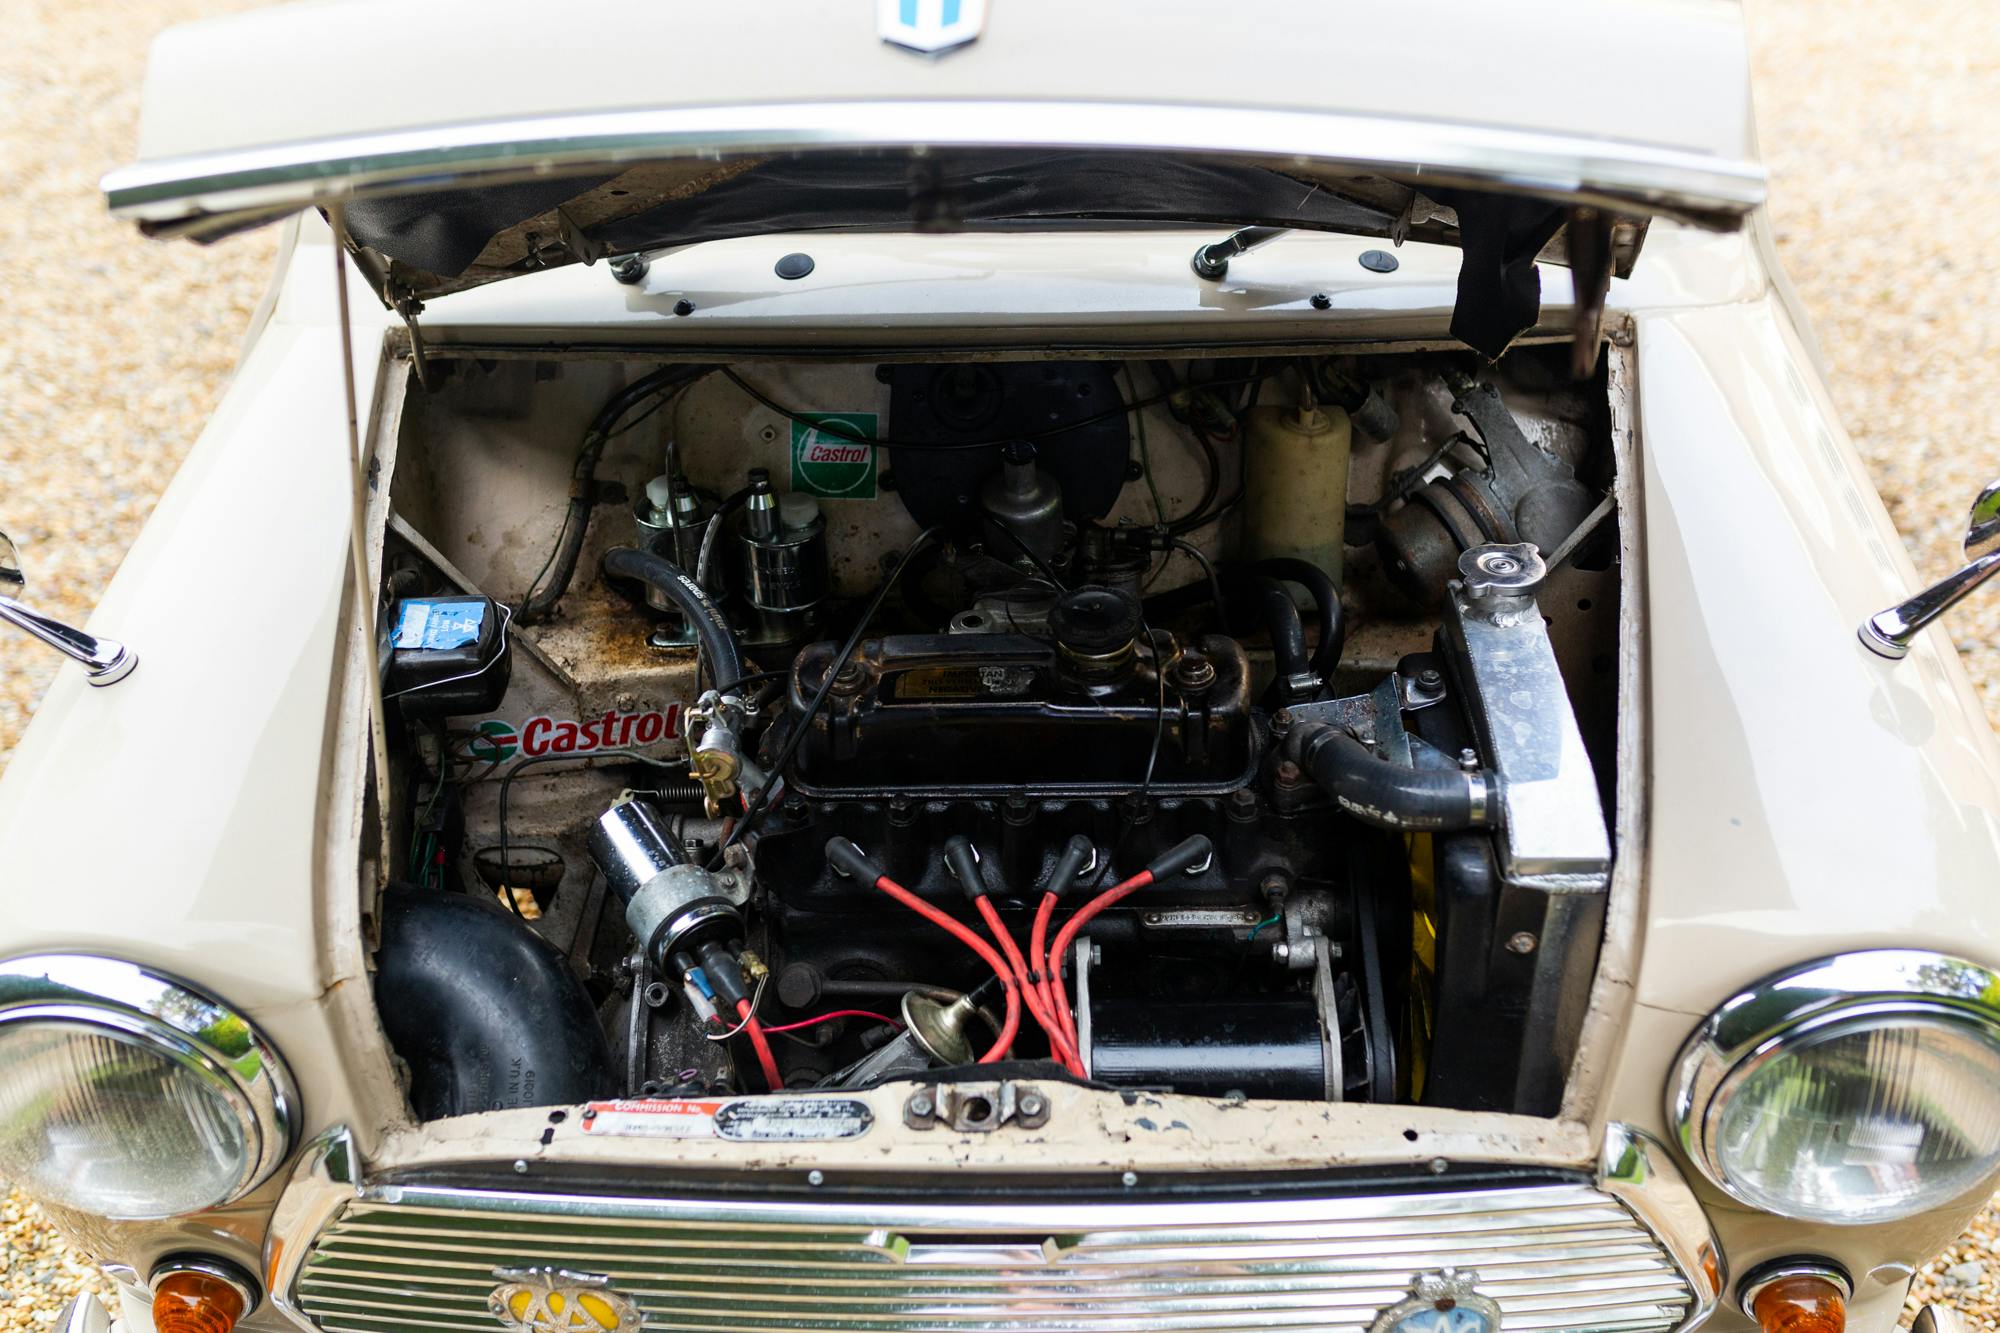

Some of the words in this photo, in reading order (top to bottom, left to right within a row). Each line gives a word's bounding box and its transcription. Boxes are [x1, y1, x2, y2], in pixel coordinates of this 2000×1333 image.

[811, 446, 868, 462] Castrol
[523, 704, 680, 756] Castrol
[614, 1102, 683, 1113] COMMISSION
